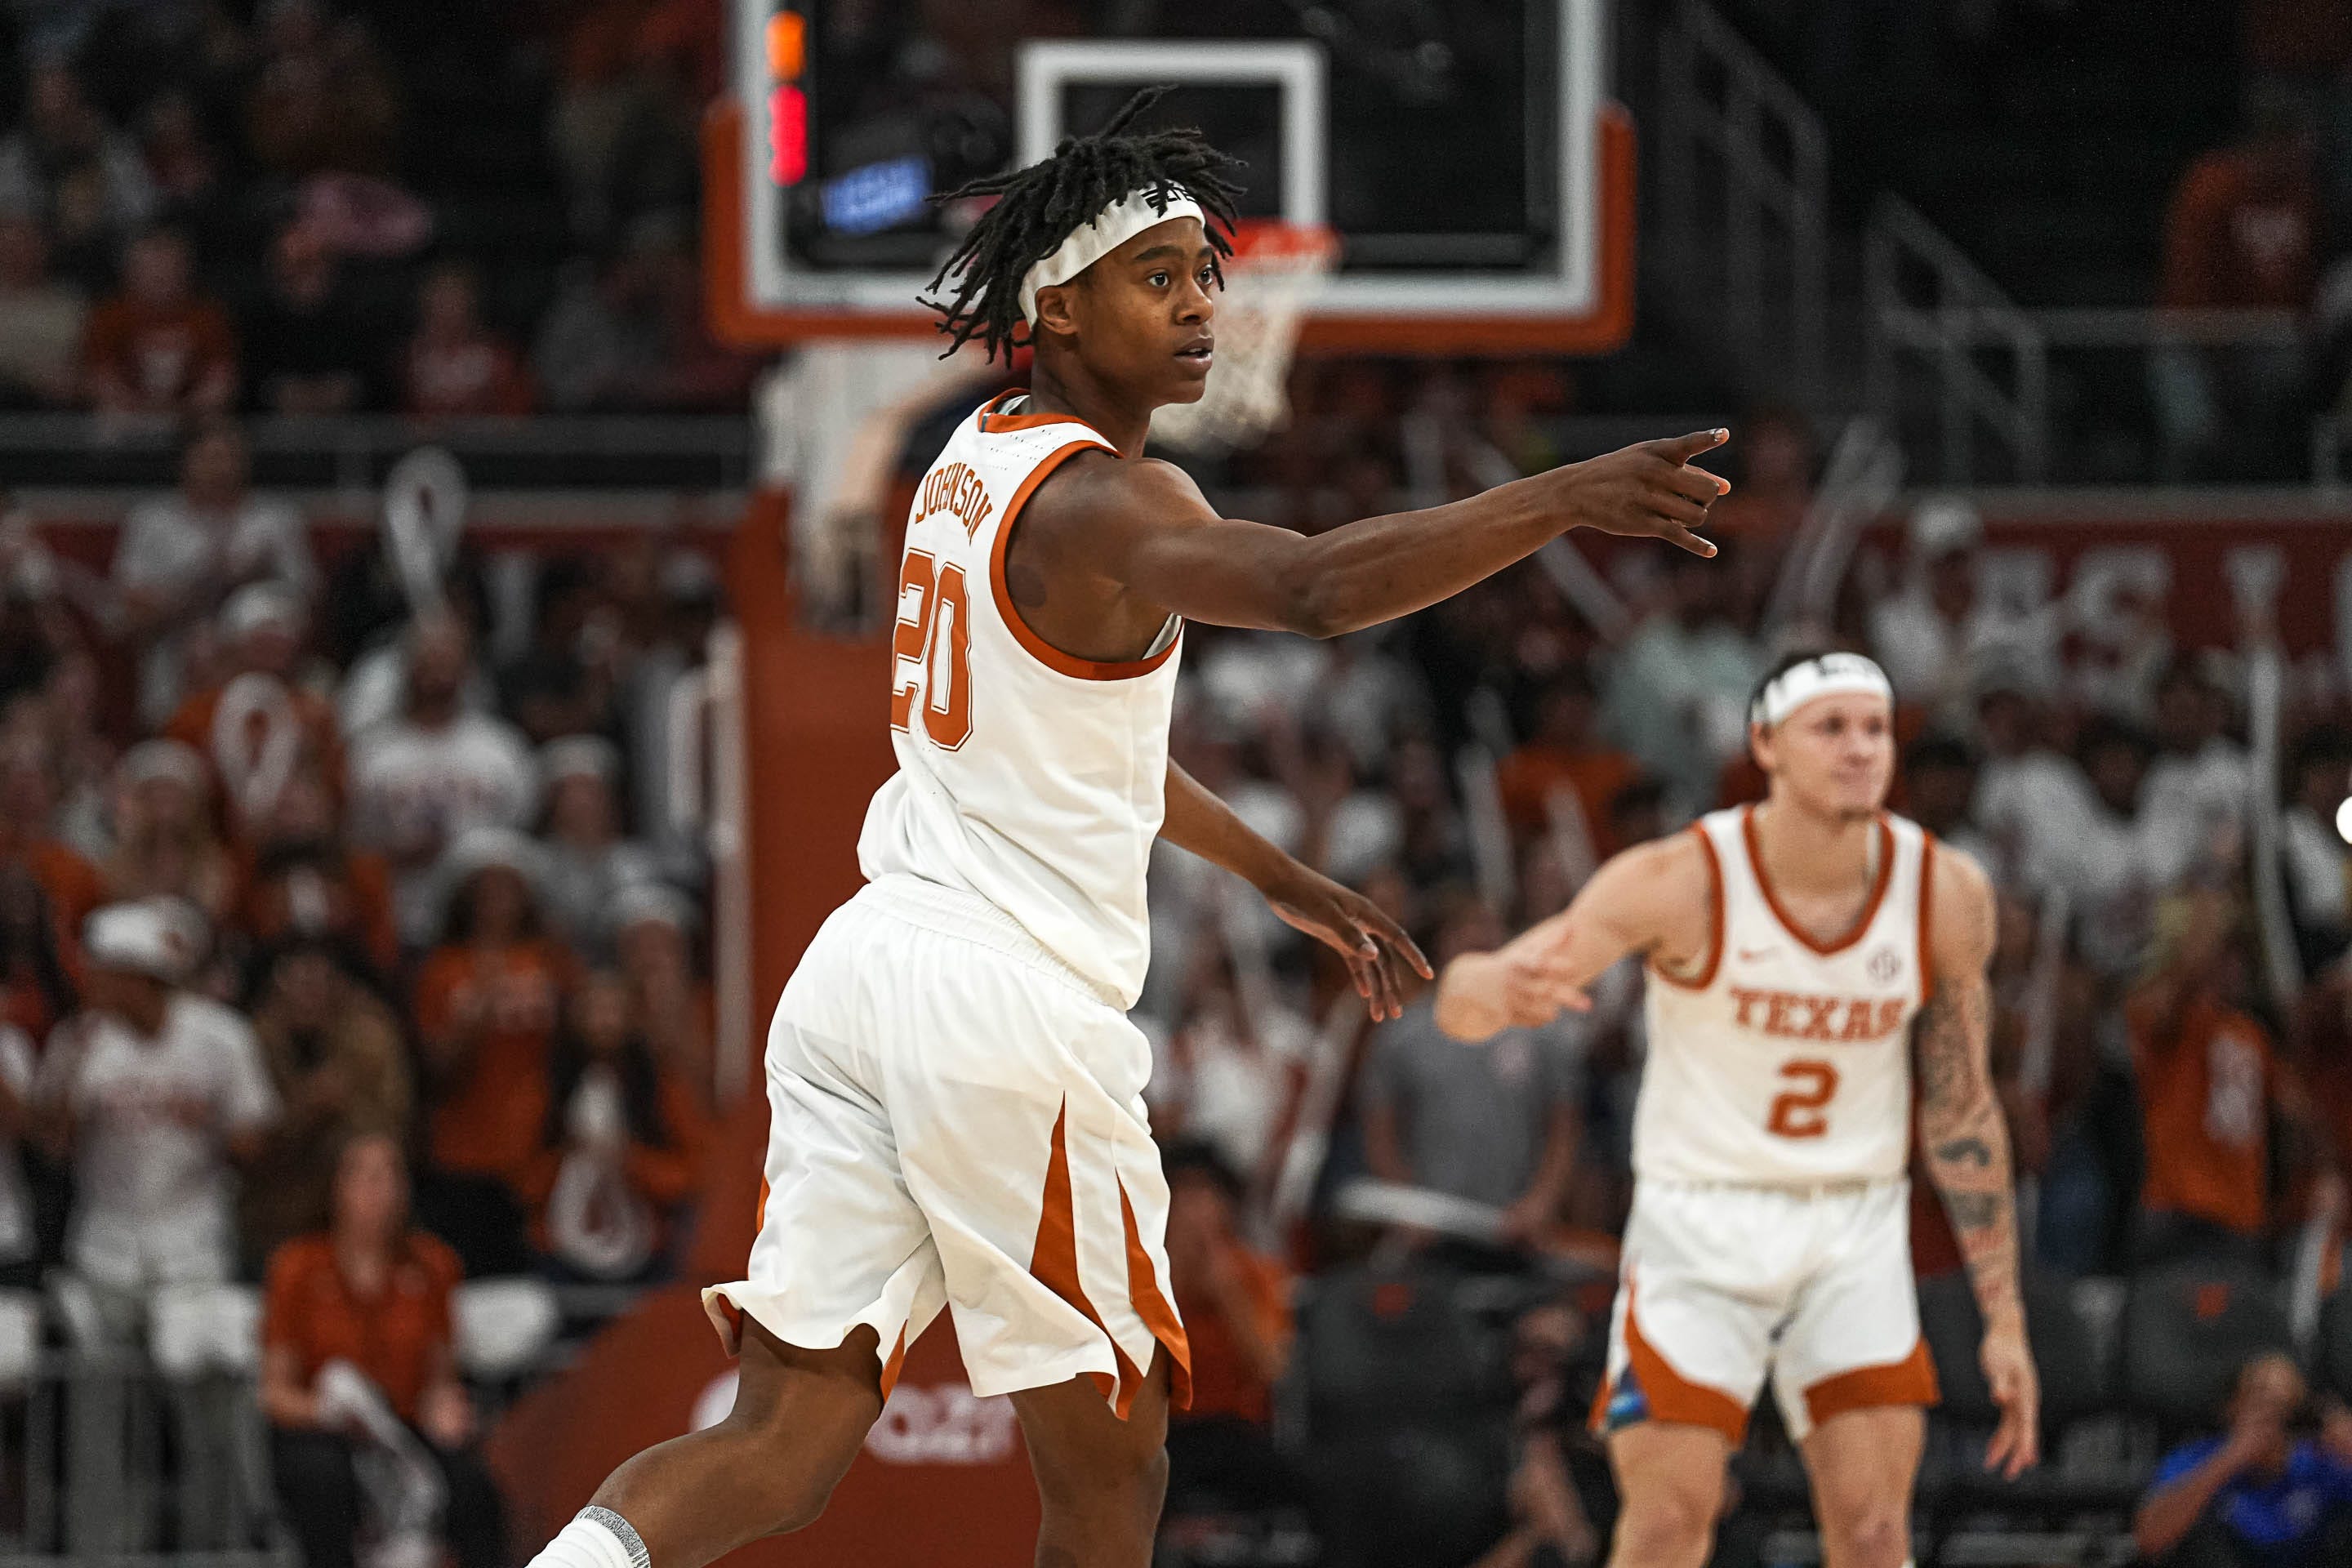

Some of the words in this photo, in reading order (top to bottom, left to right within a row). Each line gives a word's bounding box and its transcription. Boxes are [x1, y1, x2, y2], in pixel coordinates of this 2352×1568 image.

[915, 462, 993, 546] JOHNSON
[890, 547, 973, 751] 20
[1731, 987, 1906, 1041] TEXAS
[1767, 1060, 1840, 1137] 2
